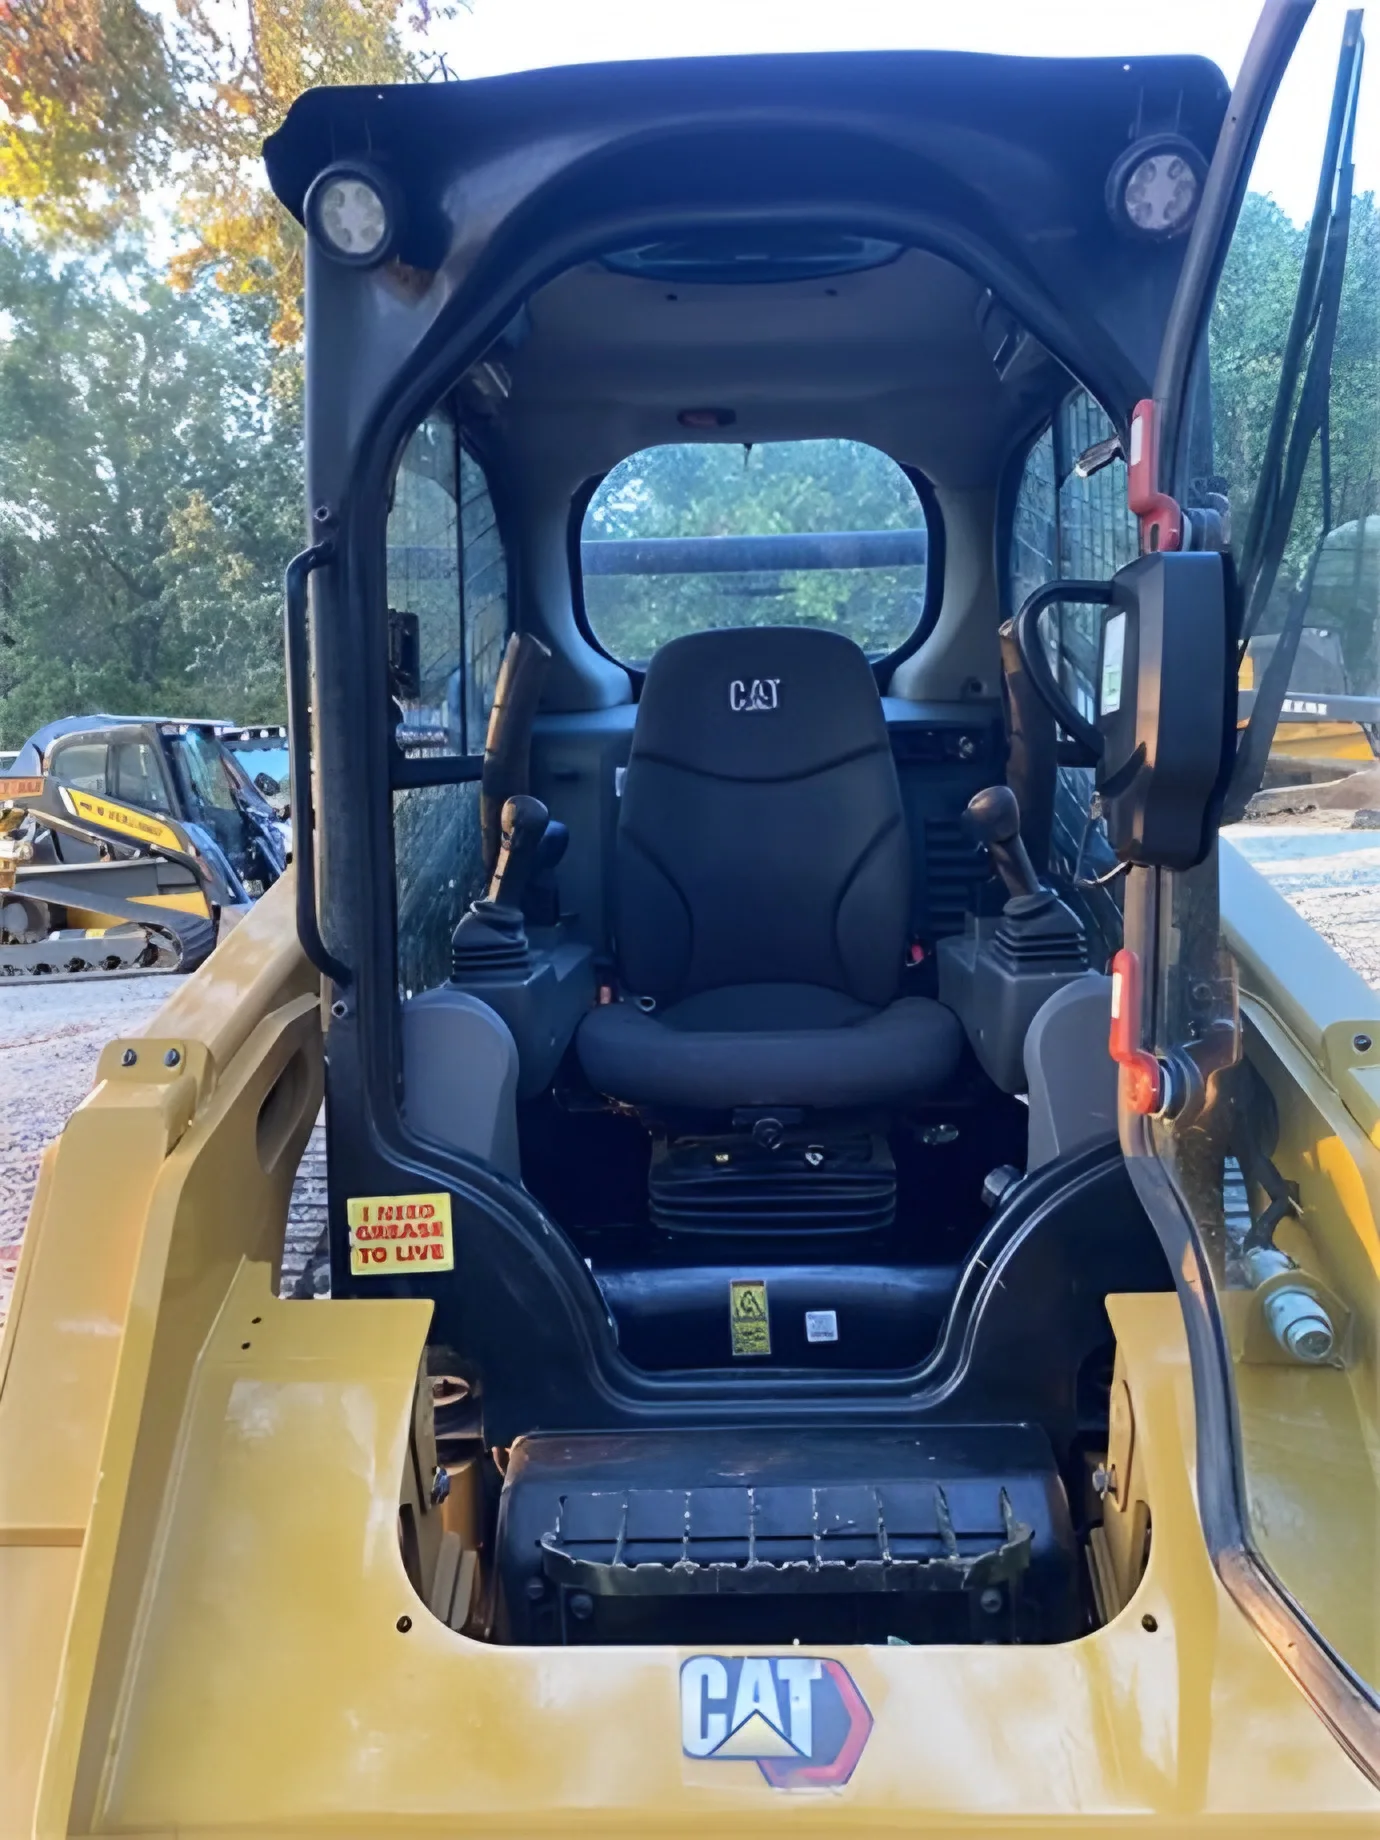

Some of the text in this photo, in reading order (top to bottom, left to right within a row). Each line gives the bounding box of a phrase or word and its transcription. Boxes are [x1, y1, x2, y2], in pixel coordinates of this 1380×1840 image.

[730, 679, 780, 711] CAT
[359, 1247, 387, 1264] TO
[681, 1656, 822, 1758] CAT
